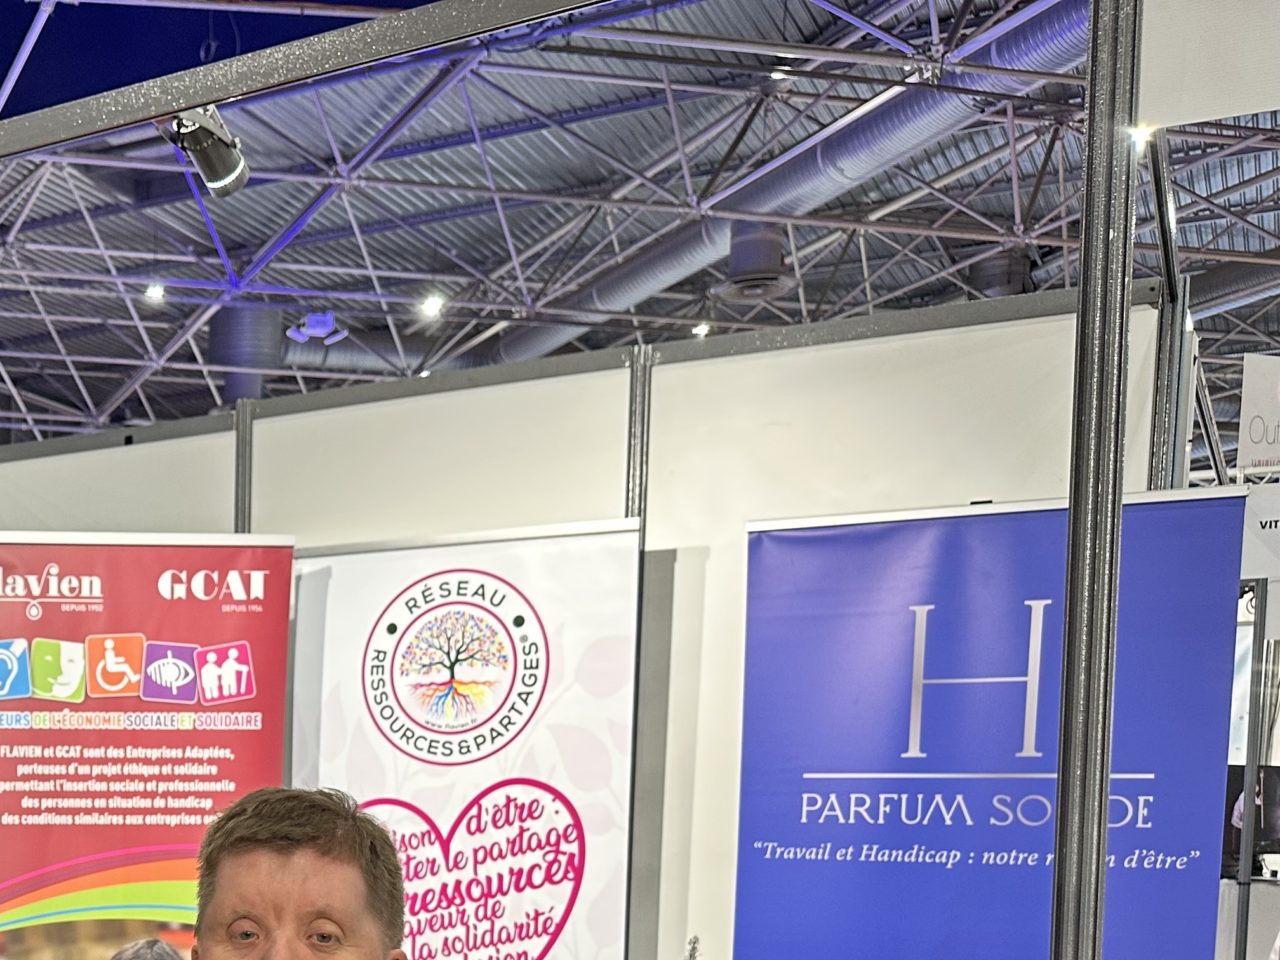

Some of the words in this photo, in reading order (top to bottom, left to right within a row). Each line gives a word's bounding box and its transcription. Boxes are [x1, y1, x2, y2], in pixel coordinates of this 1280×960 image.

[157, 569, 270, 600] GCAT
[405, 580, 506, 614] RÉSEAU
[221, 604, 247, 612] DEPUIS
[900, 599, 1052, 759] H
[370, 649, 454, 757] RESSOURCES
[458, 739, 473, 755] &
[33, 713, 50, 727] DE
[126, 713, 177, 728] SOCIALE
[180, 714, 194, 727] ET
[196, 713, 260, 728] SOLIDAIRE
[0, 744, 42, 758] FLAVIEN
[43, 746, 54, 758] et
[55, 745, 82, 758] GCAT
[82, 747, 106, 758] sont
[106, 746, 125, 758] des
[126, 745, 183, 761] Entreprises
[184, 745, 235, 761] Adaptées,
[17, 763, 67, 777] porteuses
[68, 763, 91, 775] d'un
[92, 762, 122, 777] projet
[123, 762, 160, 777] éthique
[161, 763, 173, 775] et
[173, 762, 218, 776] solidaire
[55, 779, 108, 792] l'insertion
[108, 779, 145, 792] sociale
[146, 780, 157, 792] et
[158, 779, 236, 794] professionnelle
[1, 812, 20, 825] des
[21, 812, 73, 825] conditions
[74, 812, 124, 825] similaires
[125, 815, 144, 825] aux
[144, 813, 202, 827] entreprises
[21, 796, 40, 808] des
[41, 798, 93, 811] personnes
[94, 798, 107, 808] en
[108, 796, 153, 809] situation
[153, 796, 166, 808] de
[167, 796, 213, 811] handicap
[466, 795, 545, 836] d'être
[800, 793, 974, 826] PARFUM
[989, 794, 1154, 829] SODE
[403, 854, 441, 883] ter
[473, 824, 578, 877] partage
[835, 844, 855, 861] et
[859, 844, 961, 869] Handicap
[982, 849, 1040, 866] notre
[404, 851, 579, 917] ressources
[404, 906, 470, 939] aveur
[473, 895, 506, 922] de
[441, 906, 558, 957] solidarité
